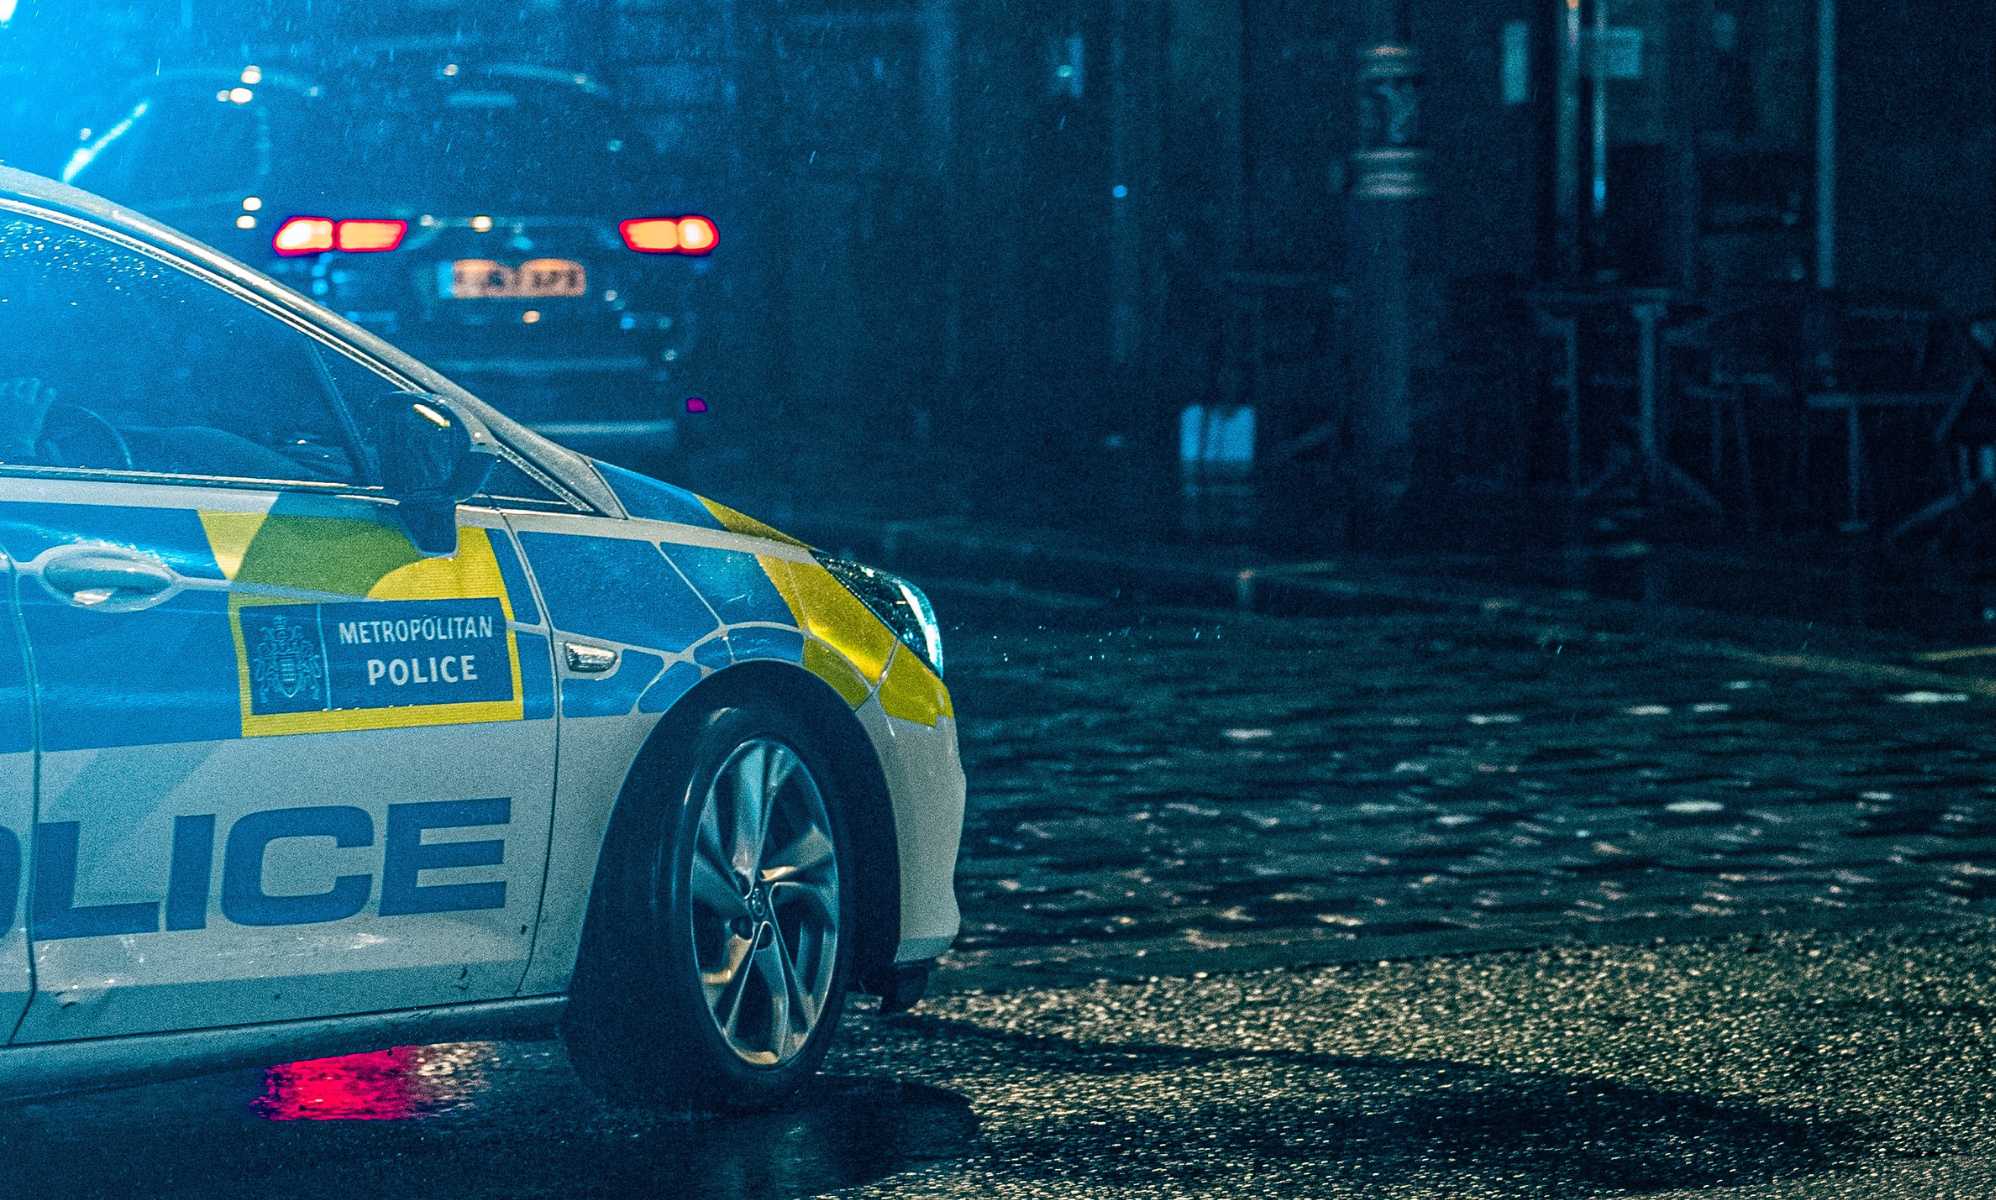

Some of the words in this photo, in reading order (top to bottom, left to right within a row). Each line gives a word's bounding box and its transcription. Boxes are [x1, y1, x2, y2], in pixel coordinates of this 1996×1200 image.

[338, 616, 493, 645] METROPOLITAN
[368, 655, 478, 686] POLICE
[0, 797, 511, 941] LICE
